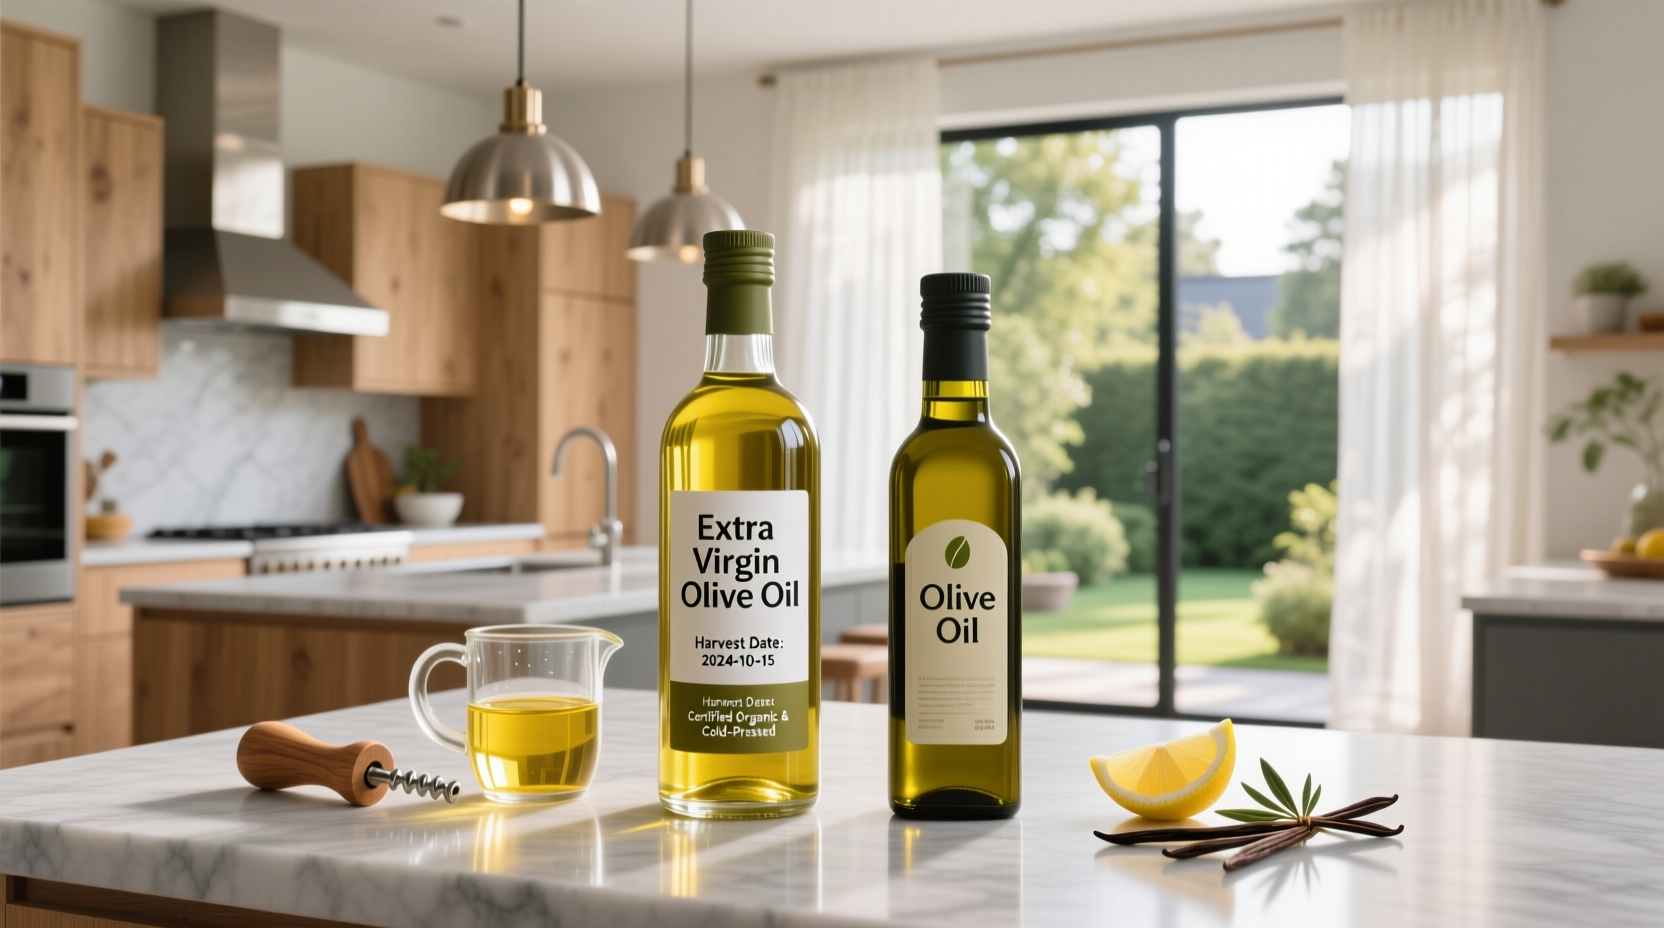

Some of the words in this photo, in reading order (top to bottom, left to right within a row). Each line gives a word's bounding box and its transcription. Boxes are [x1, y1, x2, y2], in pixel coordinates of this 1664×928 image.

[698, 514, 773, 540] Extra
[692, 547, 780, 582] Virgin
[681, 581, 754, 608] Olive
[761, 580, 799, 608] Oil
[919, 583, 996, 611] Olive
[695, 636, 746, 649] Harvest
[749, 636, 784, 649] Date:
[936, 616, 979, 644] Oil
[701, 654, 775, 667] 2024-10-15
[702, 724, 776, 738] Cold-Pressed
[736, 711, 778, 726] Organic
[781, 710, 789, 721] &
